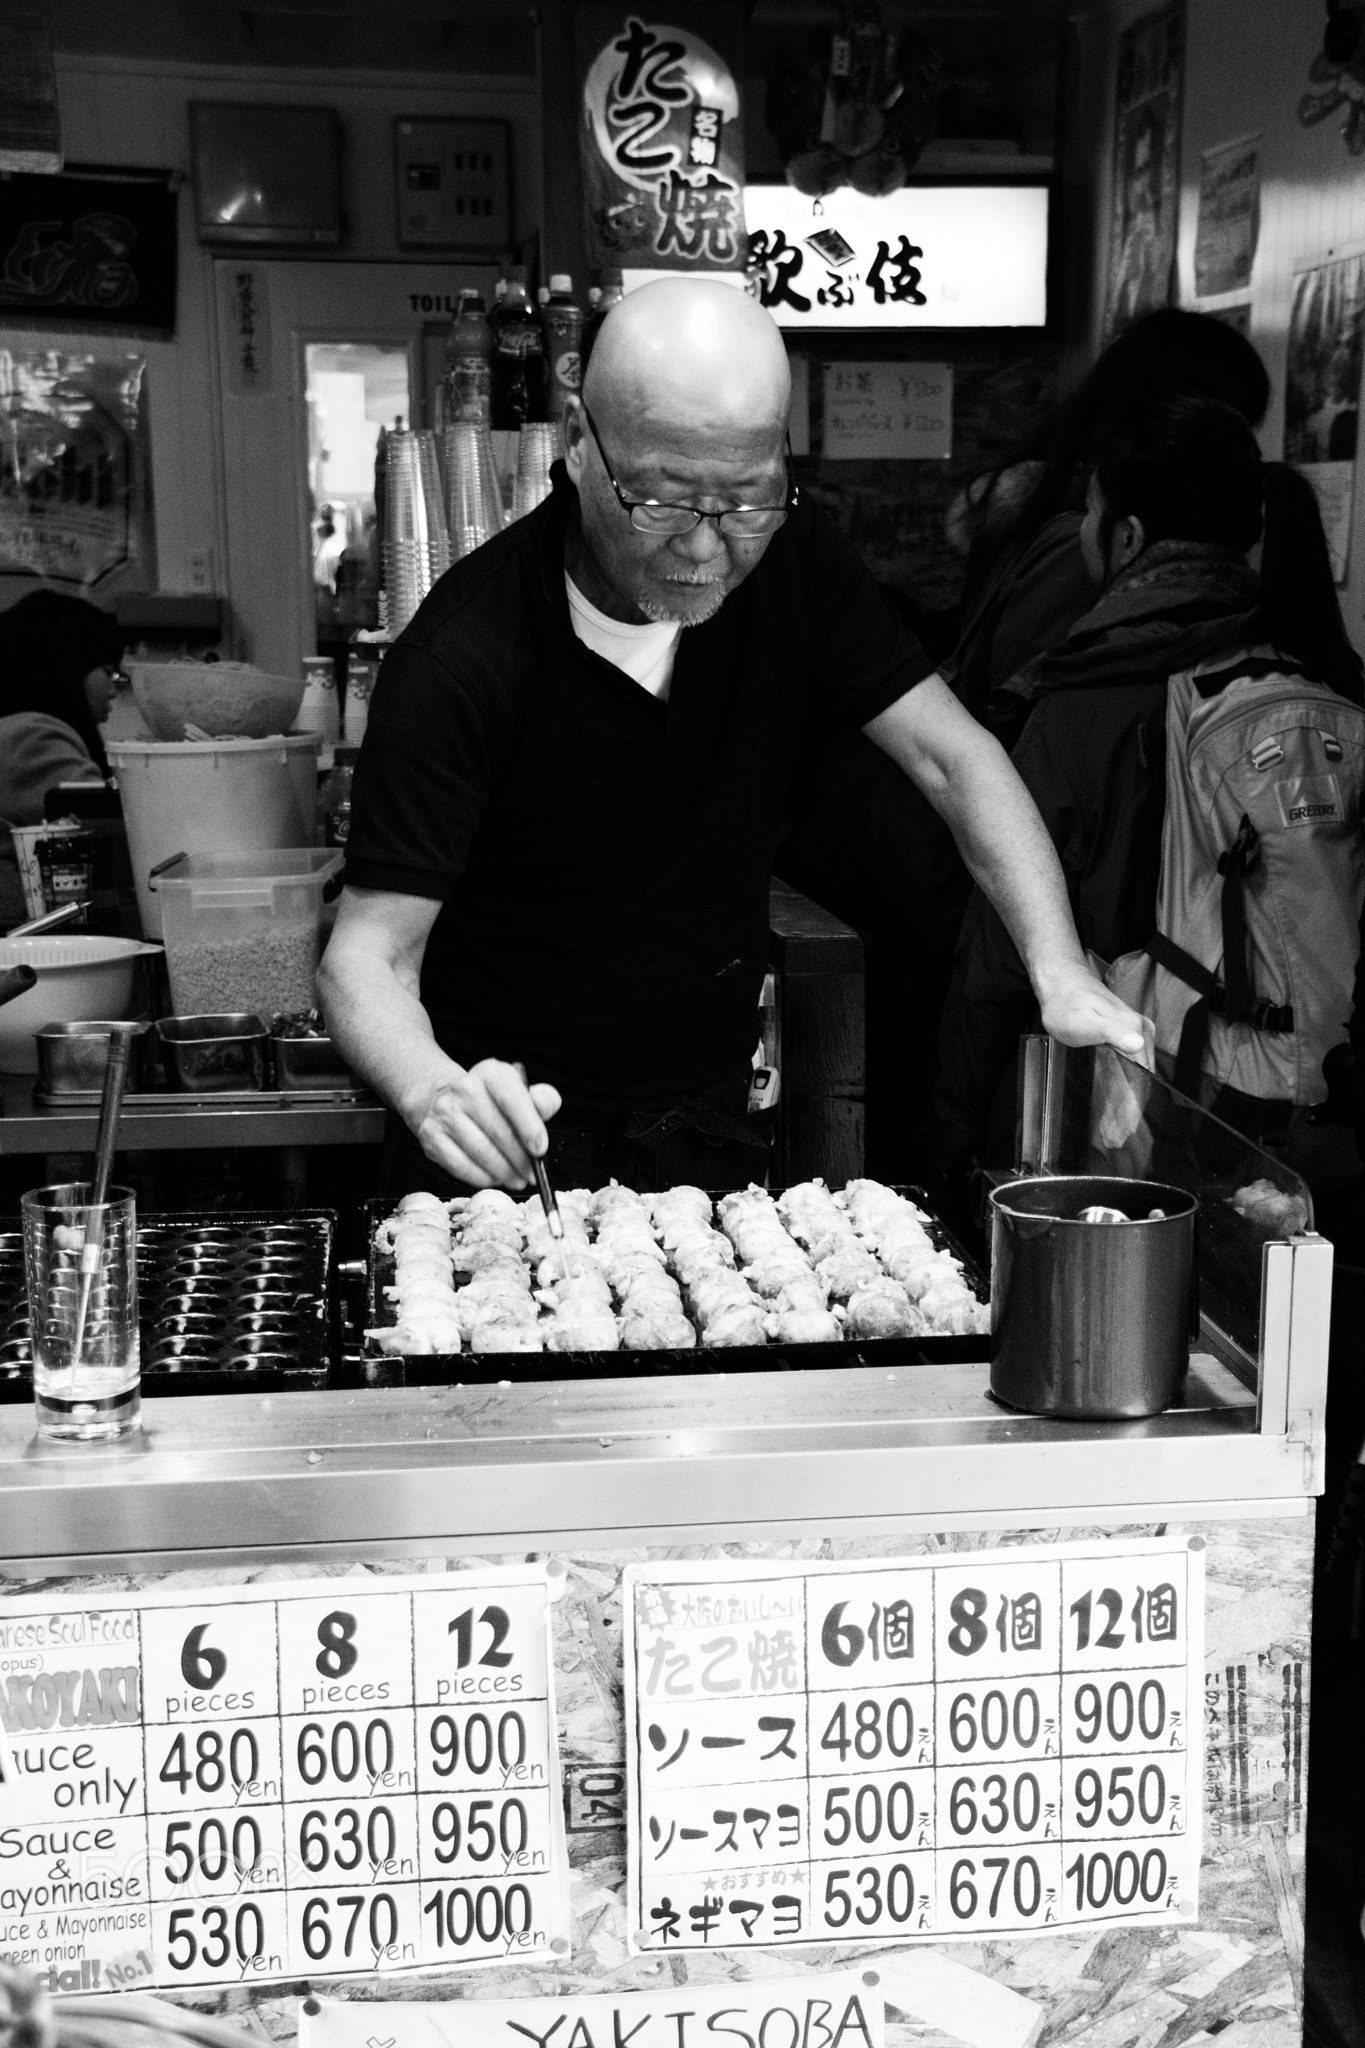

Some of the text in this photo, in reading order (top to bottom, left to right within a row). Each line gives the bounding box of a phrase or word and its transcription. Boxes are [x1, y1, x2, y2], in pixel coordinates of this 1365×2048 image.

[611, 19, 736, 260] たこ焼
[690, 110, 718, 165] 名物
[410, 295, 459, 313] TOIL
[49, 1615, 86, 1645] Soul
[89, 1608, 135, 1643] Food
[316, 1610, 358, 1679] 8
[448, 1605, 514, 1670] 12
[821, 1599, 914, 1667] 6個
[948, 1587, 1041, 1657] 8個
[1070, 1582, 1177, 1651] 12個
[181, 1622, 227, 1690] 6
[437, 1672, 523, 1704] pieces
[644, 1629, 799, 1696] たこ焼
[166, 1690, 255, 1721] pieces
[302, 1681, 390, 1711] pieces
[950, 1687, 1040, 1753] 600
[1074, 1679, 1166, 1744] 900
[159, 1727, 259, 1796] 480
[297, 1718, 394, 1786] 600
[430, 1710, 526, 1777] 900
[648, 1716, 797, 1772] ソース
[821, 1697, 914, 1762] 480
[54, 1766, 137, 1814] only
[824, 1781, 914, 1846] 500
[950, 1772, 1041, 1835] 630
[1075, 1764, 1166, 1829] 950
[0, 1828, 117, 1859] Sauce
[165, 1815, 261, 1884] 500
[300, 1805, 396, 1872] 630
[432, 1798, 528, 1864] 950
[649, 1804, 800, 1861] ソースマヨ
[0, 1872, 142, 1918] ayonnaise
[48, 1858, 72, 1881] &
[824, 1863, 914, 1927] 530
[950, 1855, 1041, 1919] 670
[1066, 1848, 1167, 1911] 1000
[37, 1919, 49, 1940] &
[56, 1908, 148, 1941] Mayonnaise
[168, 1903, 264, 1970] 530
[302, 1893, 398, 1960] 670
[424, 1883, 532, 1948] 1000
[650, 1895, 802, 1944] ネギマヨ
[0, 1940, 87, 1966] reen onion
[104, 1949, 154, 1988] No.1
